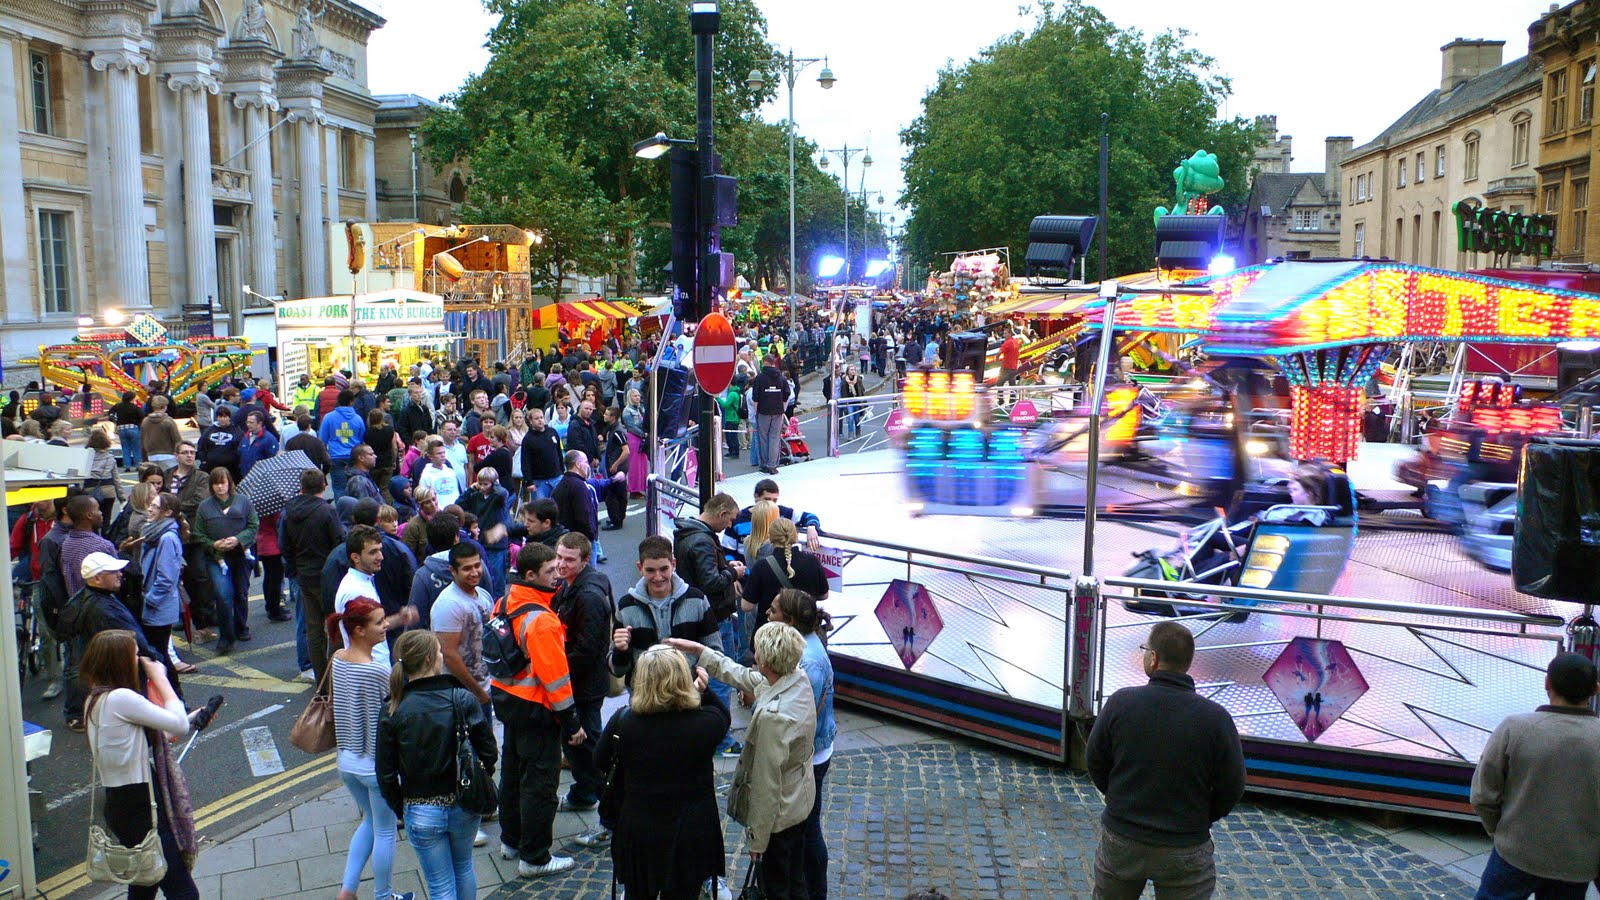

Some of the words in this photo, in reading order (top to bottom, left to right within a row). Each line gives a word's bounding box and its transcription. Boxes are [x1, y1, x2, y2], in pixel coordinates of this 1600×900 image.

[279, 306, 312, 318] ROAST
[319, 304, 349, 318] PORK
[355, 307, 375, 320] THE
[380, 307, 404, 319] KING
[406, 306, 442, 318] BURGER
